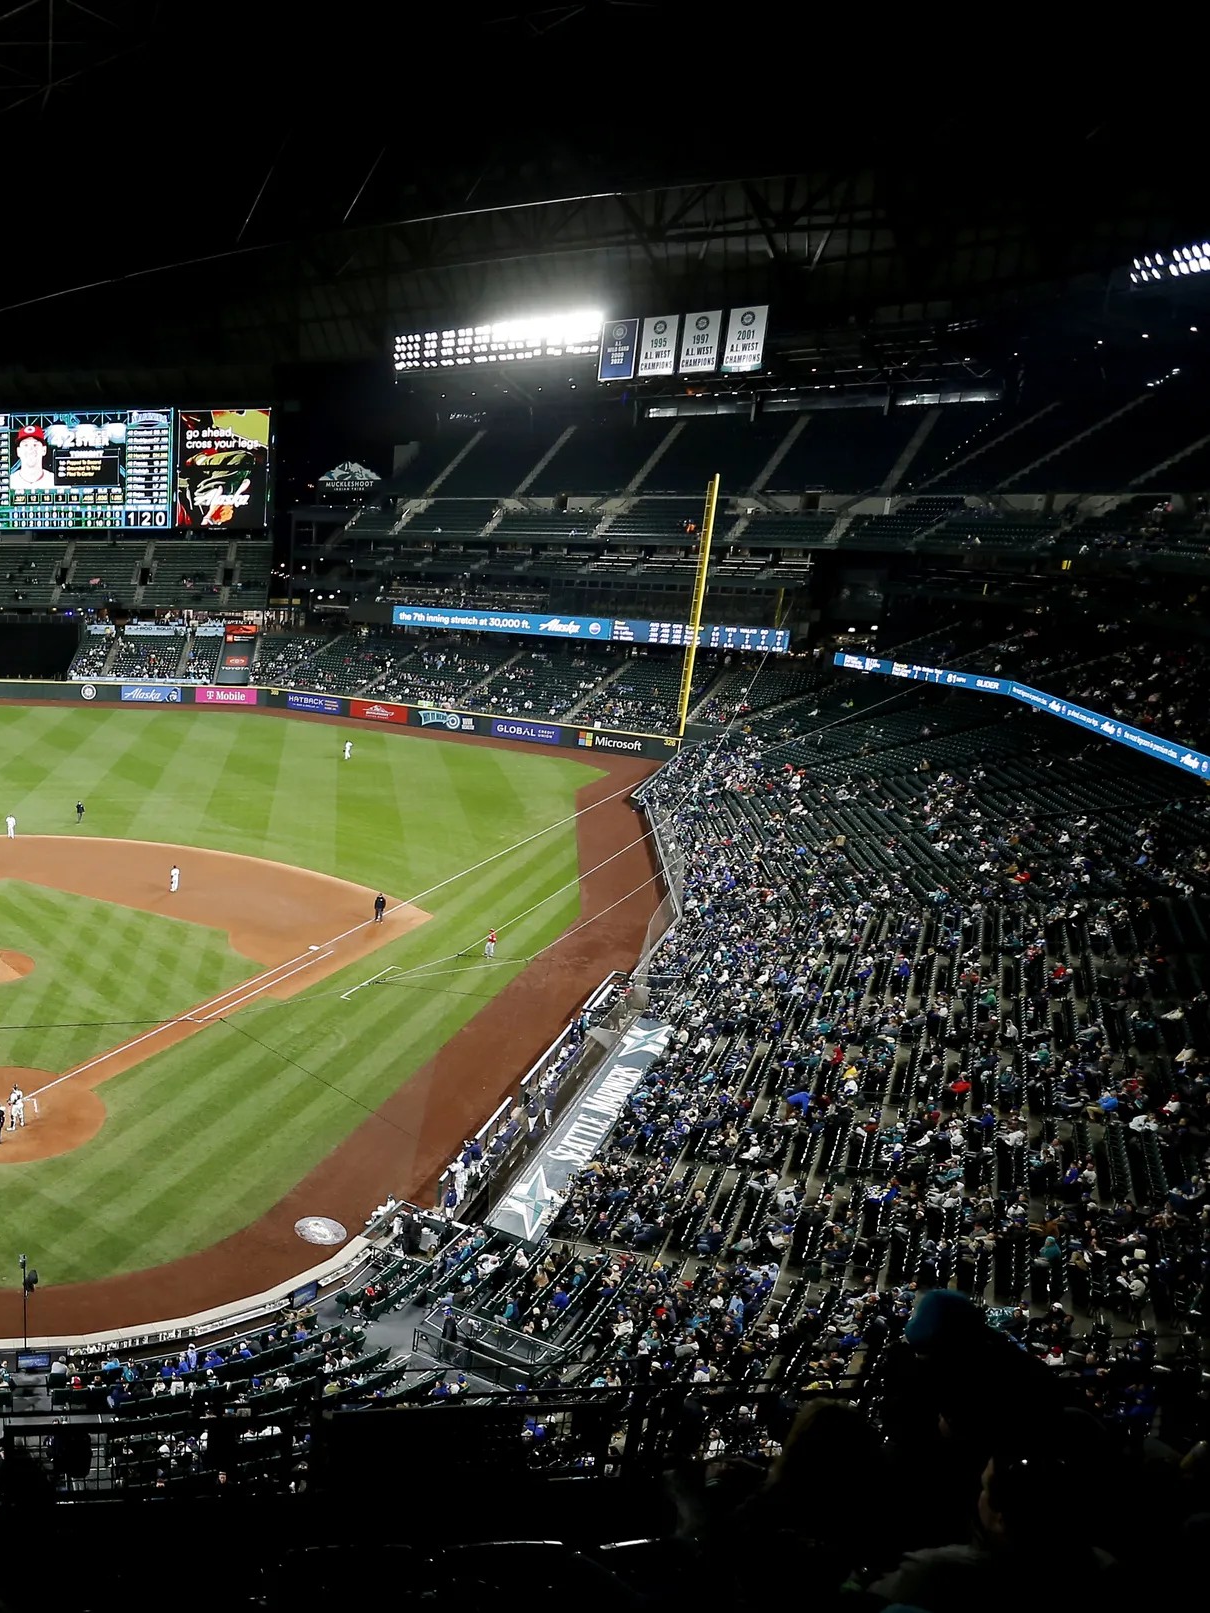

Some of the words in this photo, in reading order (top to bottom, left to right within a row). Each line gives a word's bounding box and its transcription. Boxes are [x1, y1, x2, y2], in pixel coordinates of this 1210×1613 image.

[693, 334, 709, 344] 1997
[737, 330, 755, 340] 2001
[651, 338, 667, 348] 1995
[730, 344, 740, 352] A.L.
[742, 342, 758, 351] WEST
[655, 350, 671, 359] WEST
[686, 348, 695, 356] A.L.
[697, 346, 713, 355] WEST
[681, 357, 715, 367] CHAMPIONS
[725, 353, 760, 364] CHAMPIONS
[641, 361, 672, 370] CHAMPIONS
[186, 430, 199, 440] go
[202, 427, 233, 439] ahead,
[186, 440, 212, 449] cross
[214, 440, 237, 450] your
[238, 437, 260, 450] legs.
[128, 512, 134, 525] 1
[142, 512, 151, 526] 2
[156, 512, 165, 526] 0
[399, 612, 412, 620] the
[413, 613, 425, 622] 7th
[426, 614, 449, 625] inning
[451, 616, 477, 625] stretch
[479, 618, 487, 626] at
[489, 618, 520, 629] 30,000
[521, 619, 531, 629] ft.
[539, 619, 580, 634] Alaska
[946, 674, 956, 683] 81
[976, 679, 999, 689] SLIDER
[124, 688, 162, 701] Alaska
[206, 691, 214, 700] T
[216, 691, 245, 701] Mobile
[288, 696, 323, 706] HATBACK
[497, 724, 536, 737] GLOBAL
[595, 736, 643, 751] Microsoft
[547, 1112, 611, 1166] SEATTLE
[581, 1064, 643, 1122] MARINERS
